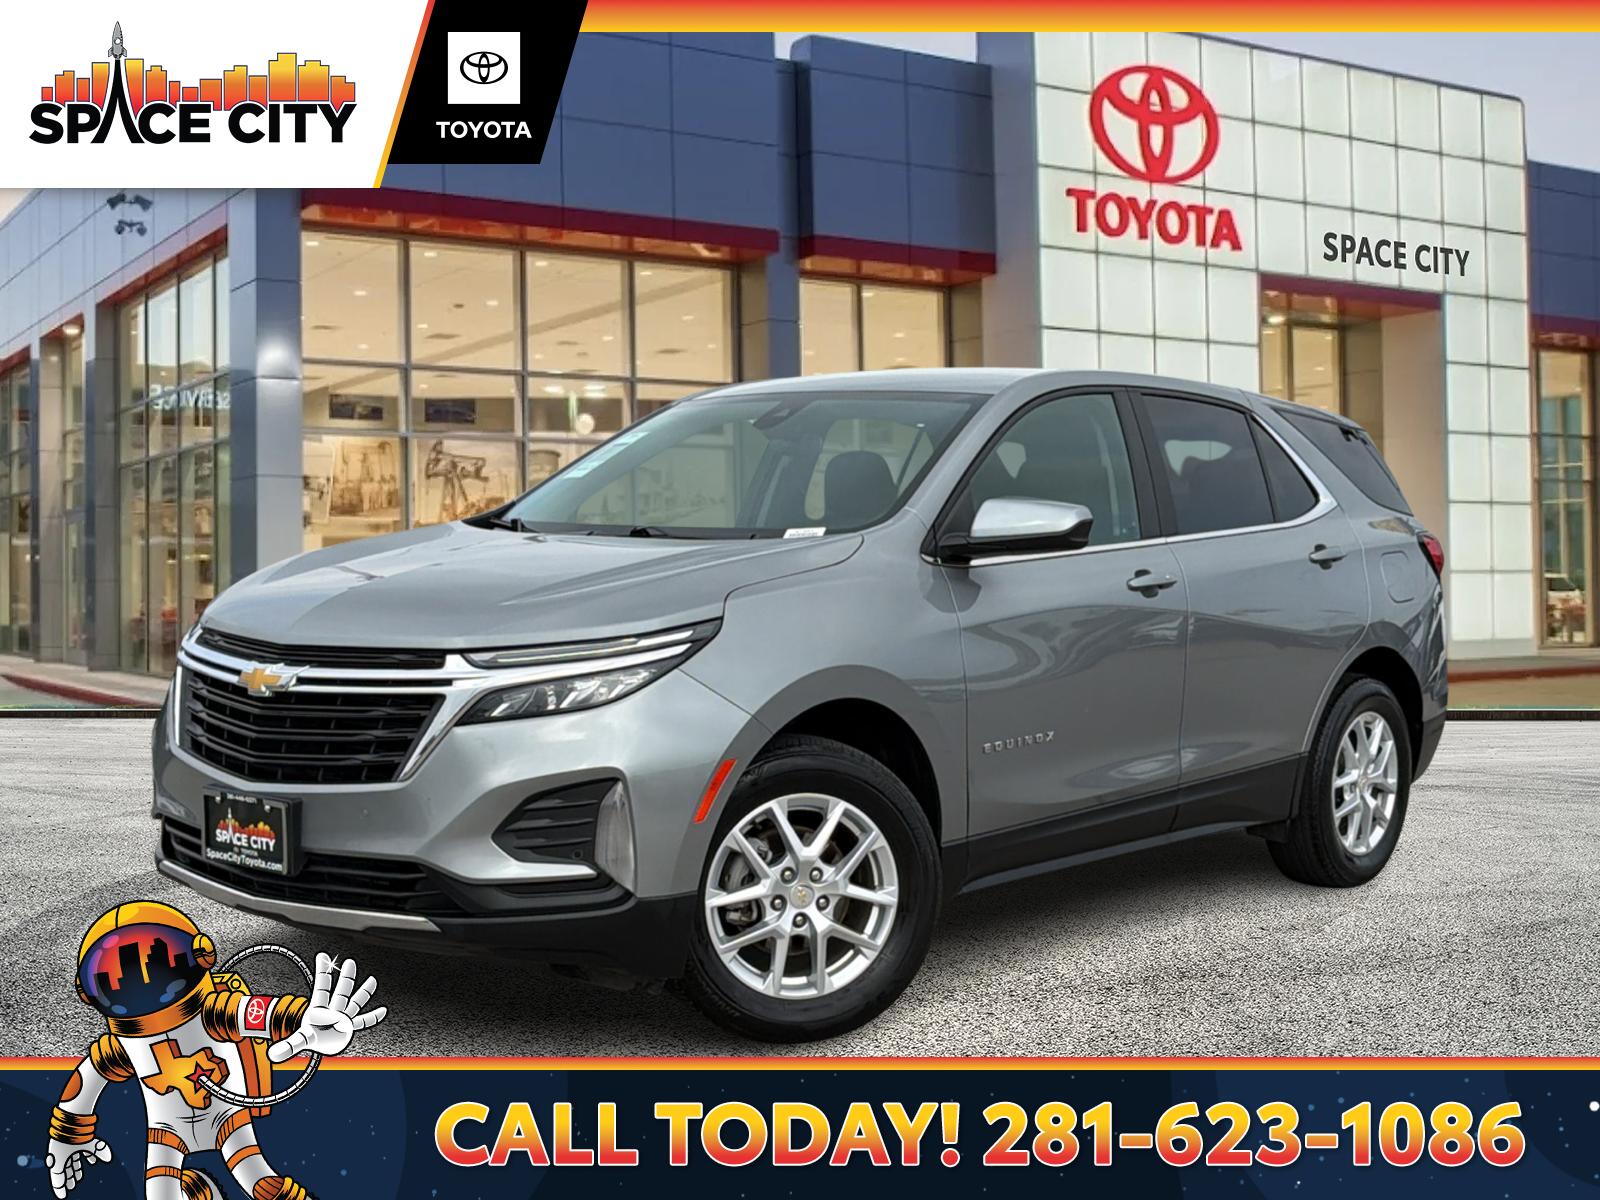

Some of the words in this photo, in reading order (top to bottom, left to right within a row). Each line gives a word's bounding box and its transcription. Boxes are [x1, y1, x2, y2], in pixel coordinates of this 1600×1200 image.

[1066, 187, 1243, 251] TOYOTA
[1322, 231, 1407, 270] SPACE
[1414, 244, 1471, 277] CITY
[982, 731, 1055, 755] EQUINOX
[215, 828, 249, 847] SPACE
[250, 836, 276, 852] CITY
[206, 847, 283, 872] SpaceCityToyota.com
